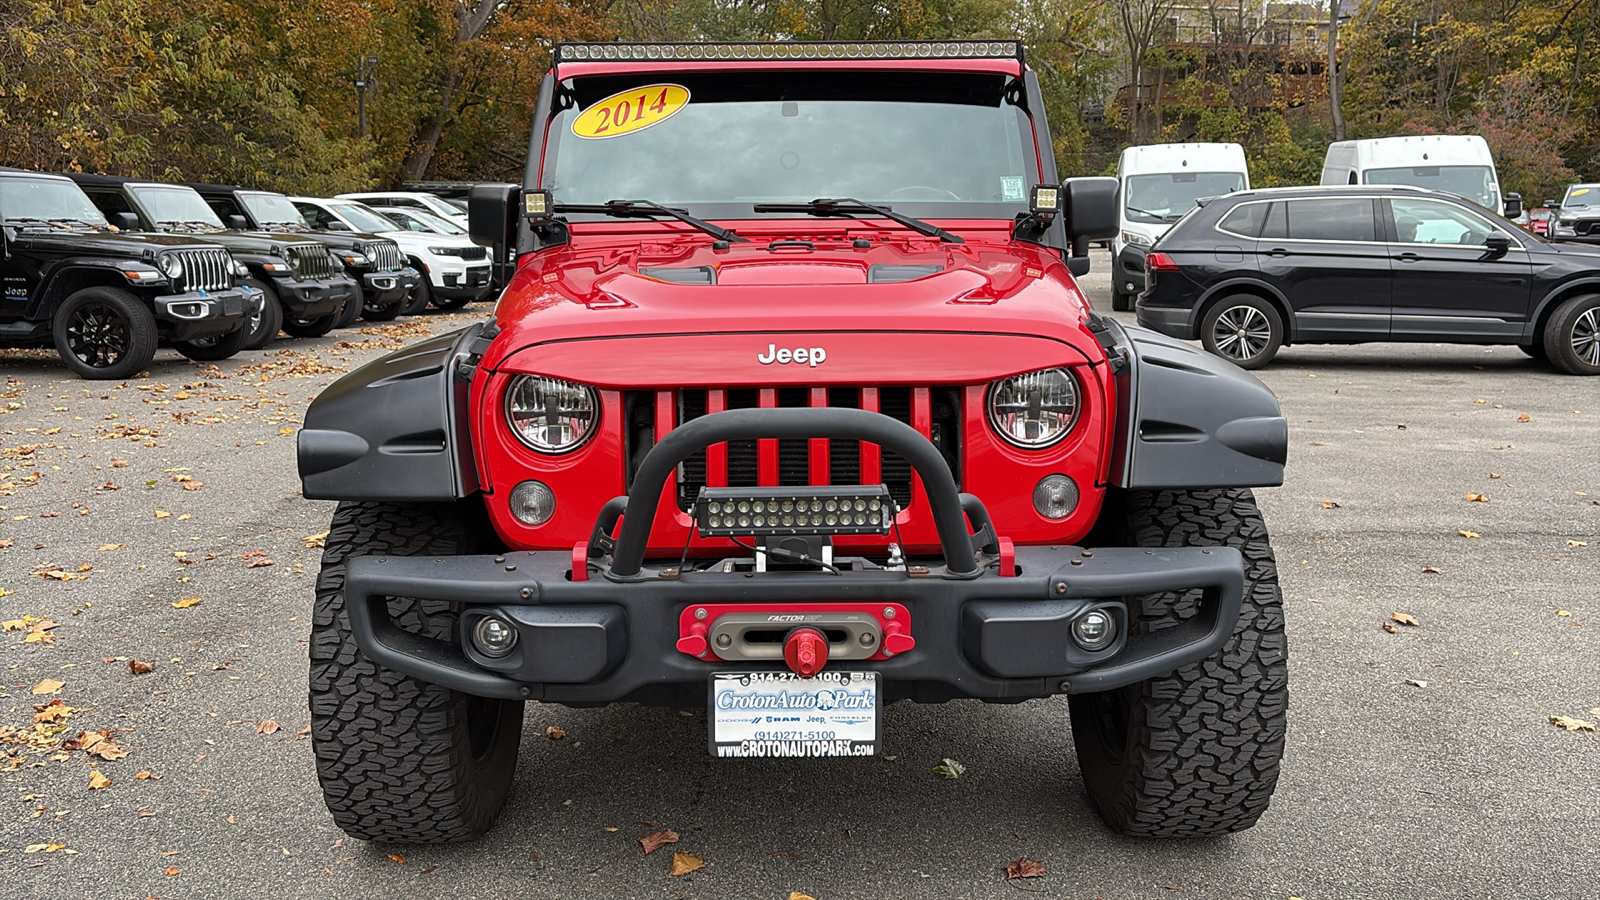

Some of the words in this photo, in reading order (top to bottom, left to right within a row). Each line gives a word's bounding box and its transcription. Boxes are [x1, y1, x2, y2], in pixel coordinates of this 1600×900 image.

[593, 87, 668, 135] 2014
[4, 286, 27, 296] Jeep
[757, 343, 827, 368] Jeep
[750, 672, 842, 683] 914-27100
[806, 715, 827, 724] Jeep
[754, 731, 836, 740] (914)271-5100
